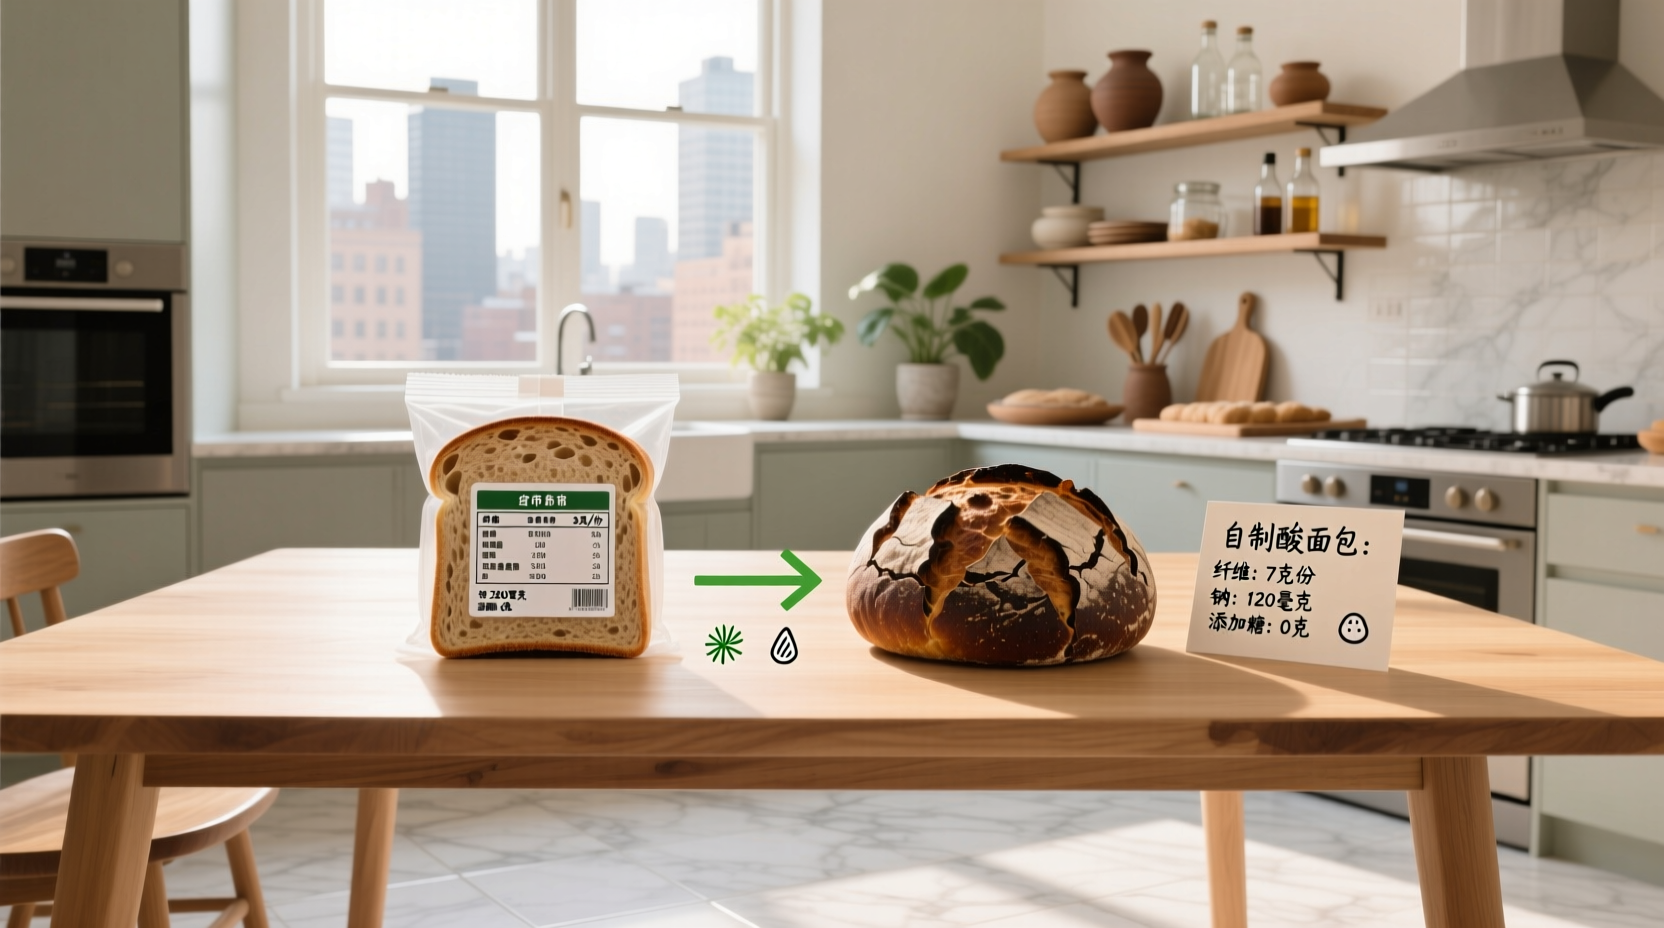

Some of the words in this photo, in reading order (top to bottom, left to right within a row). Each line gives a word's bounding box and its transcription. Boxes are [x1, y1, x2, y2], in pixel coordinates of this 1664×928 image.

[1225, 521, 1370, 556] 自制酸面包:
